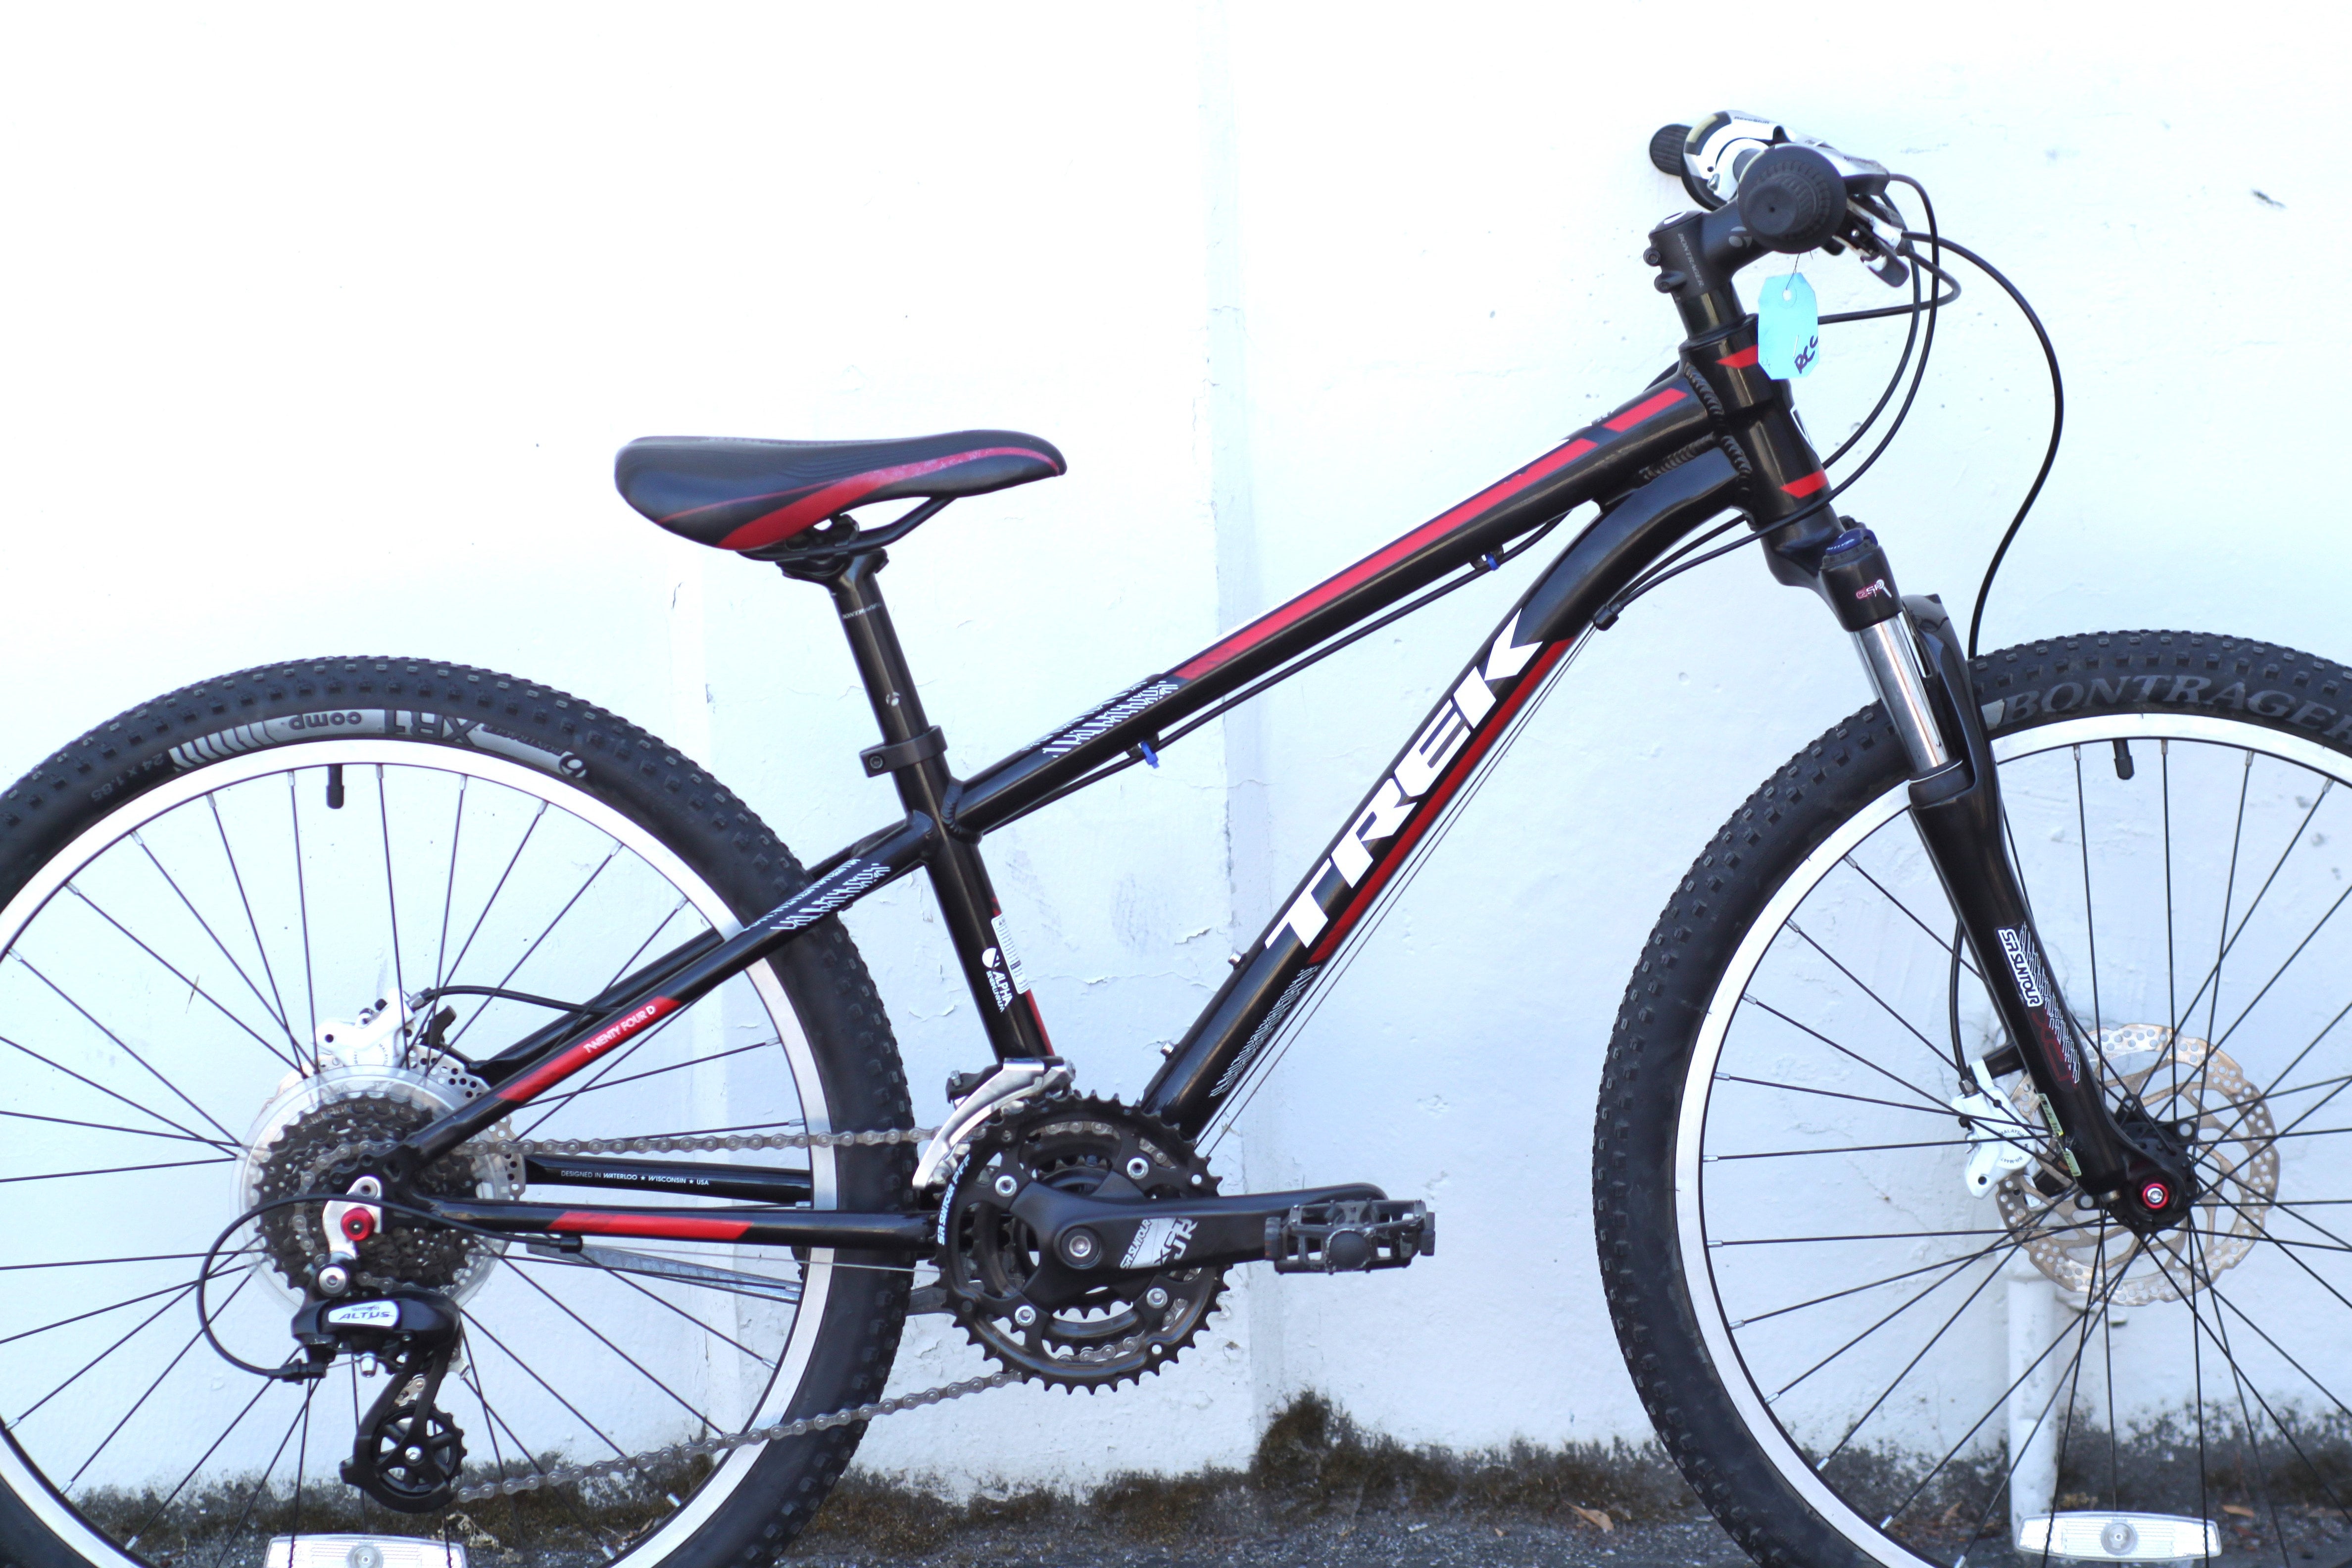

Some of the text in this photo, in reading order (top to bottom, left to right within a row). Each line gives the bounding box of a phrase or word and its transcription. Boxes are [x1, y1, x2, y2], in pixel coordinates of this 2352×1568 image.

[289, 711, 361, 731] comp
[384, 709, 479, 748] XR1
[142, 752, 164, 771] 24
[1265, 607, 1543, 949] TREK
[91, 776, 125, 802] 1.85
[992, 971, 1013, 1007] ALPHA
[2009, 952, 2041, 1005] SUNTOUR
[583, 1005, 656, 1053] TWENTY FOUR D
[603, 1172, 637, 1180] WATERLOO
[648, 1175, 686, 1183] WISCONSIN
[939, 1183, 955, 1226] SUNTOUR
[1127, 1219, 1152, 1258] SUNTOUR
[338, 1311, 394, 1321] ALTUS
